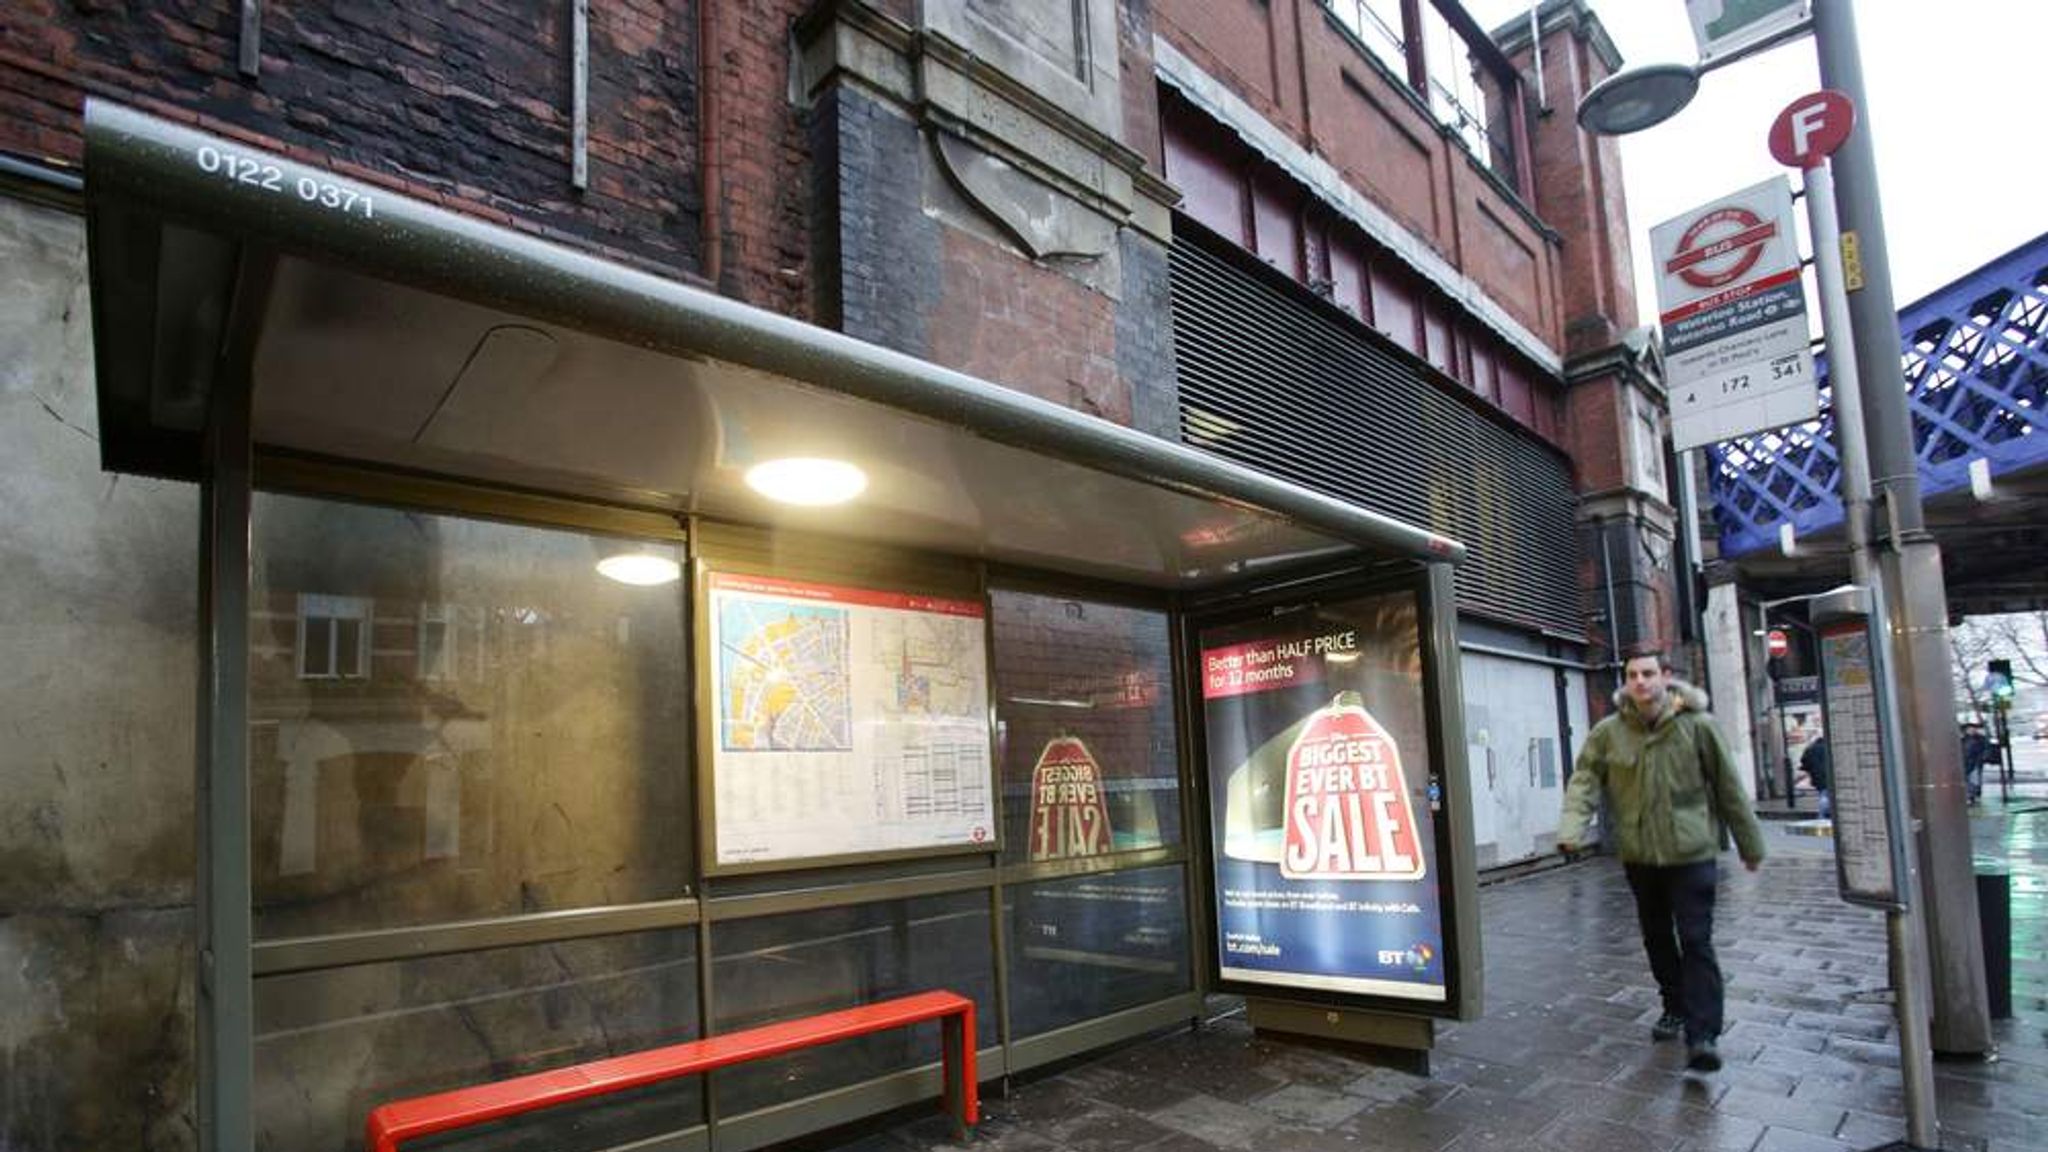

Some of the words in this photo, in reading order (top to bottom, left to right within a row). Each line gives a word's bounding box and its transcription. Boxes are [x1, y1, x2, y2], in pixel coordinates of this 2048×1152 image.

[1791, 102, 1827, 156] F
[198, 147, 282, 192] 0122
[297, 178, 373, 218] 0371
[1704, 240, 1732, 257] BUS
[1677, 306, 1735, 331] Waterloo
[1728, 308, 1762, 328] Road
[1687, 392, 1697, 403] 4
[1721, 374, 1750, 394] 172
[1771, 360, 1802, 380] 341
[1208, 654, 1244, 672] Better
[1246, 649, 1275, 664] than
[1277, 639, 1312, 661] HALF
[1315, 631, 1356, 655] PRICE
[1210, 674, 1225, 688] for
[1228, 670, 1243, 685] 12
[1245, 664, 1295, 683] months
[1300, 741, 1380, 768] BIGGEST
[1296, 764, 1358, 796] EVER
[1360, 763, 1389, 791] BT
[1287, 791, 1416, 872] SALE
[1378, 950, 1405, 965] BT
